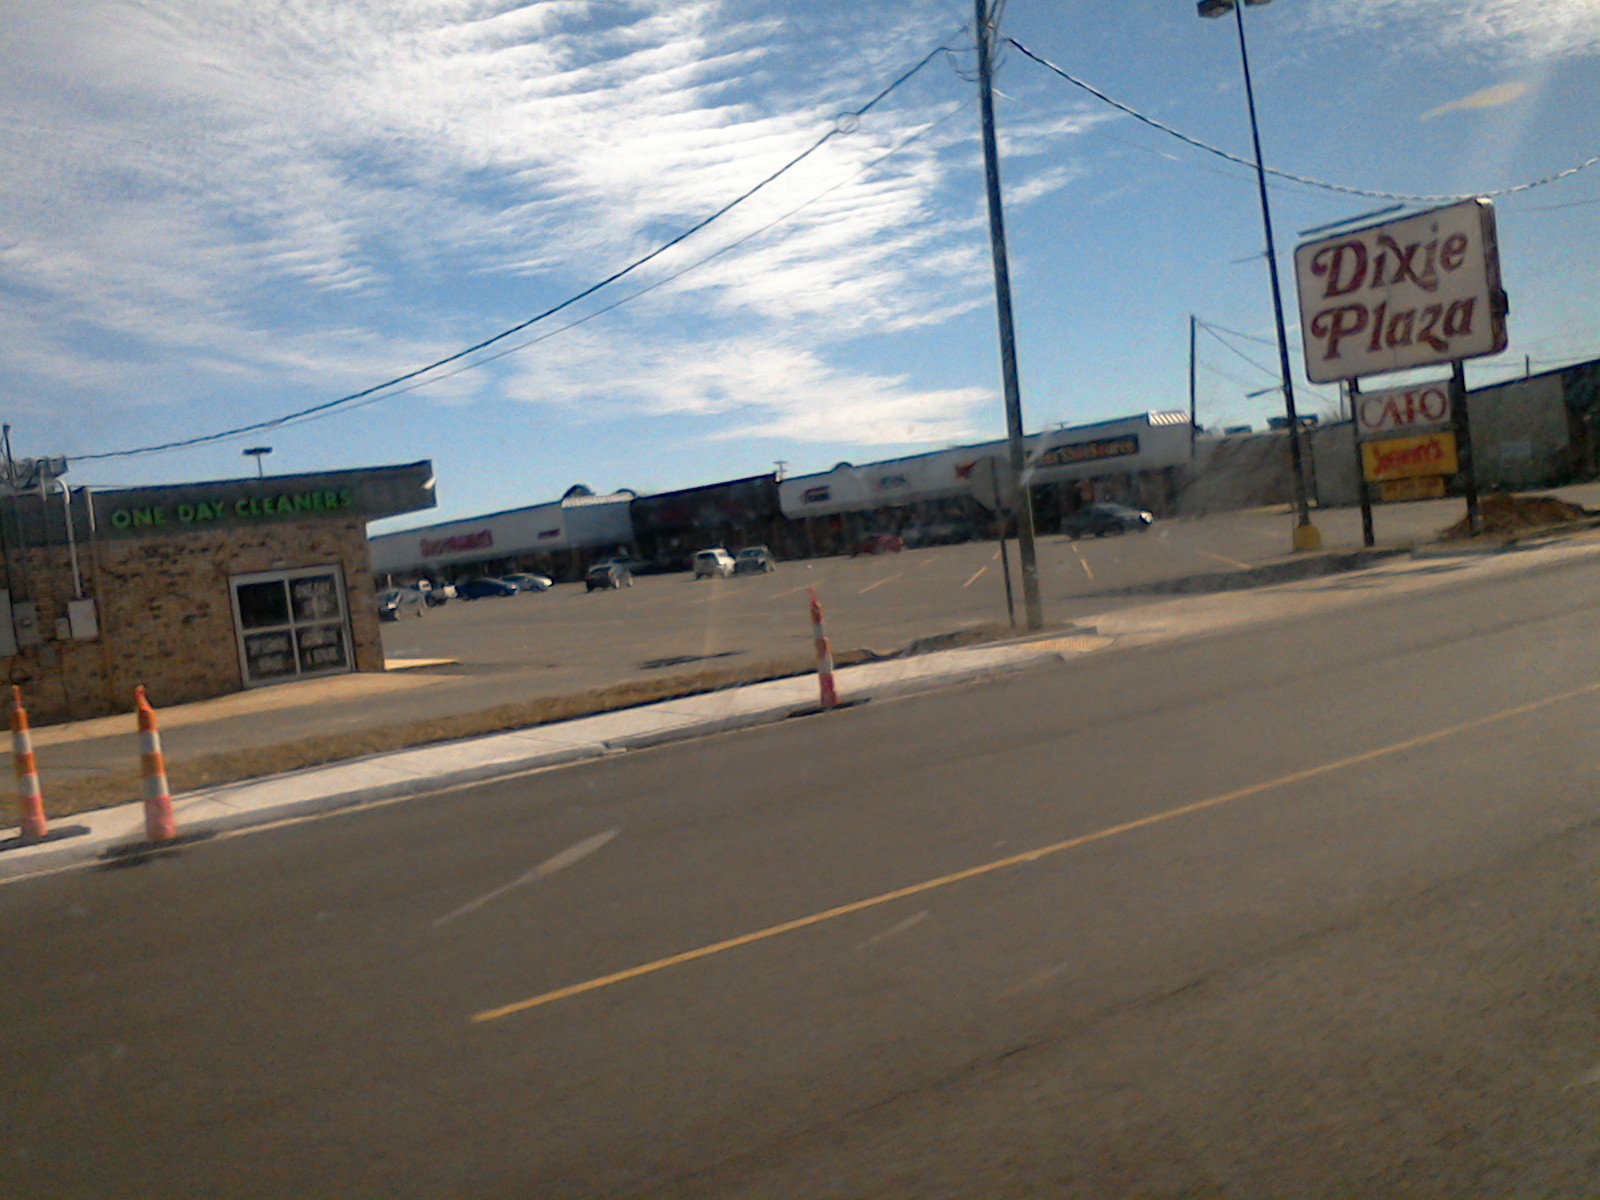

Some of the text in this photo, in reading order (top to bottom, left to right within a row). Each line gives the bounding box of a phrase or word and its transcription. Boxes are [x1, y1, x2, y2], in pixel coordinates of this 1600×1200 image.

[1311, 222, 1468, 298] Dixie
[1311, 296, 1478, 360] Plaza
[111, 489, 352, 529] ONE DAY CLEANERS
